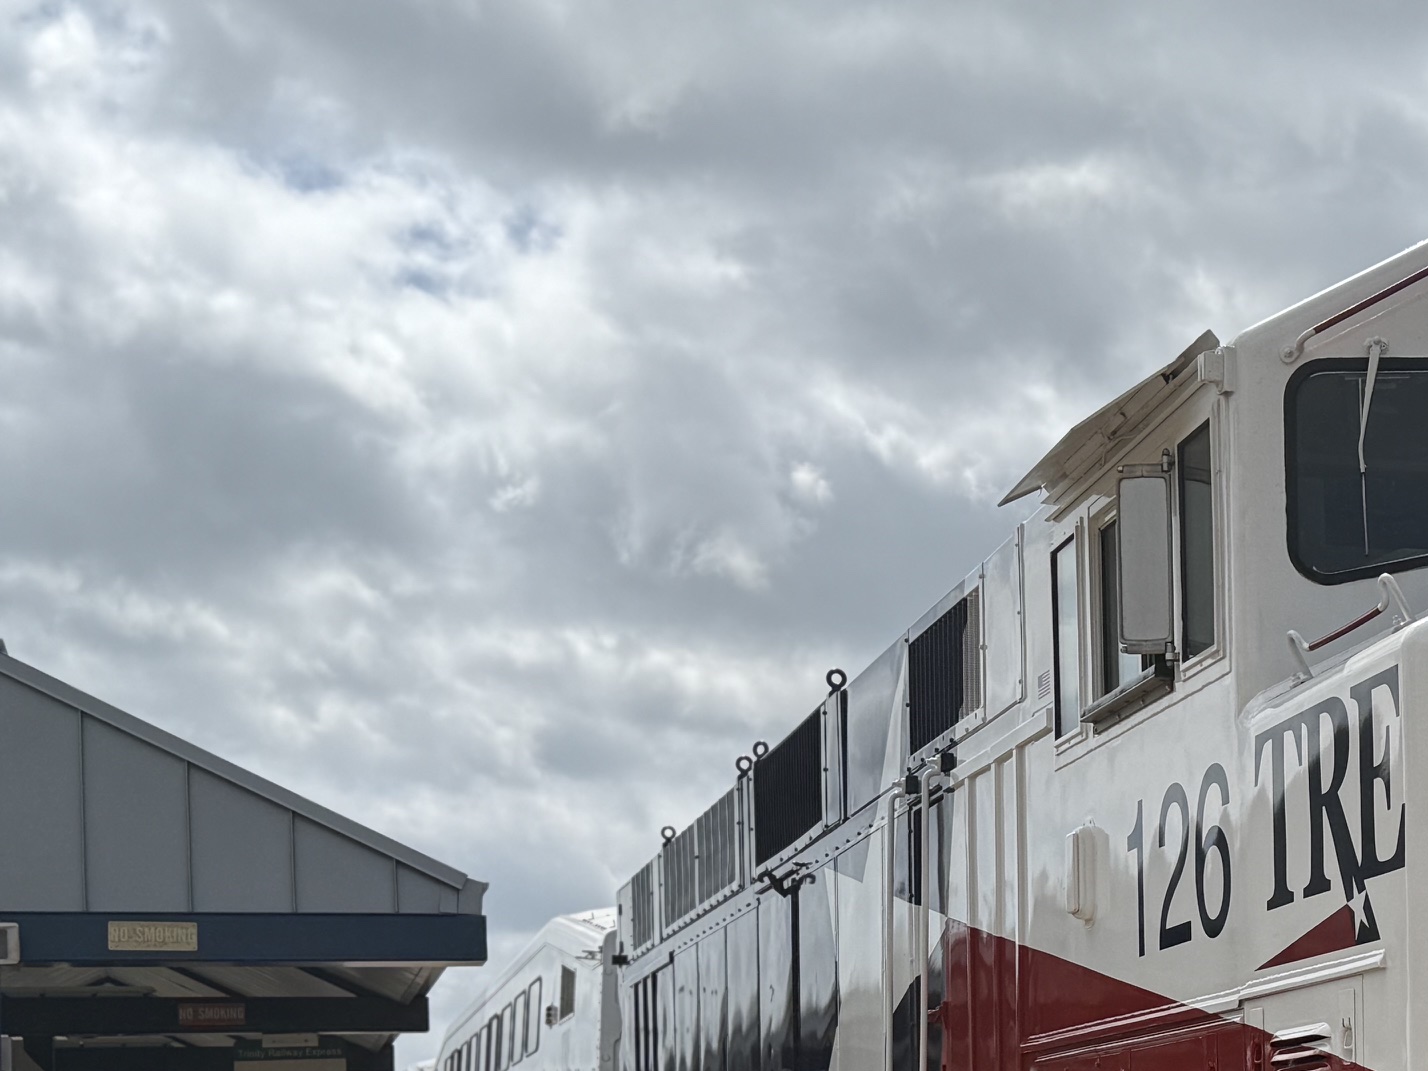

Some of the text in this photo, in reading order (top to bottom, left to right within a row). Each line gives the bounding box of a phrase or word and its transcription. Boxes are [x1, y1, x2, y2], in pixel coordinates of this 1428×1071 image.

[1254, 664, 1405, 944] TRE
[1126, 762, 1231, 957] 126
[110, 926, 196, 942] NO SMOKING
[179, 1007, 245, 1020] NO SMOKING
[238, 1049, 265, 1059] Trinity
[305, 1048, 342, 1057] Express
